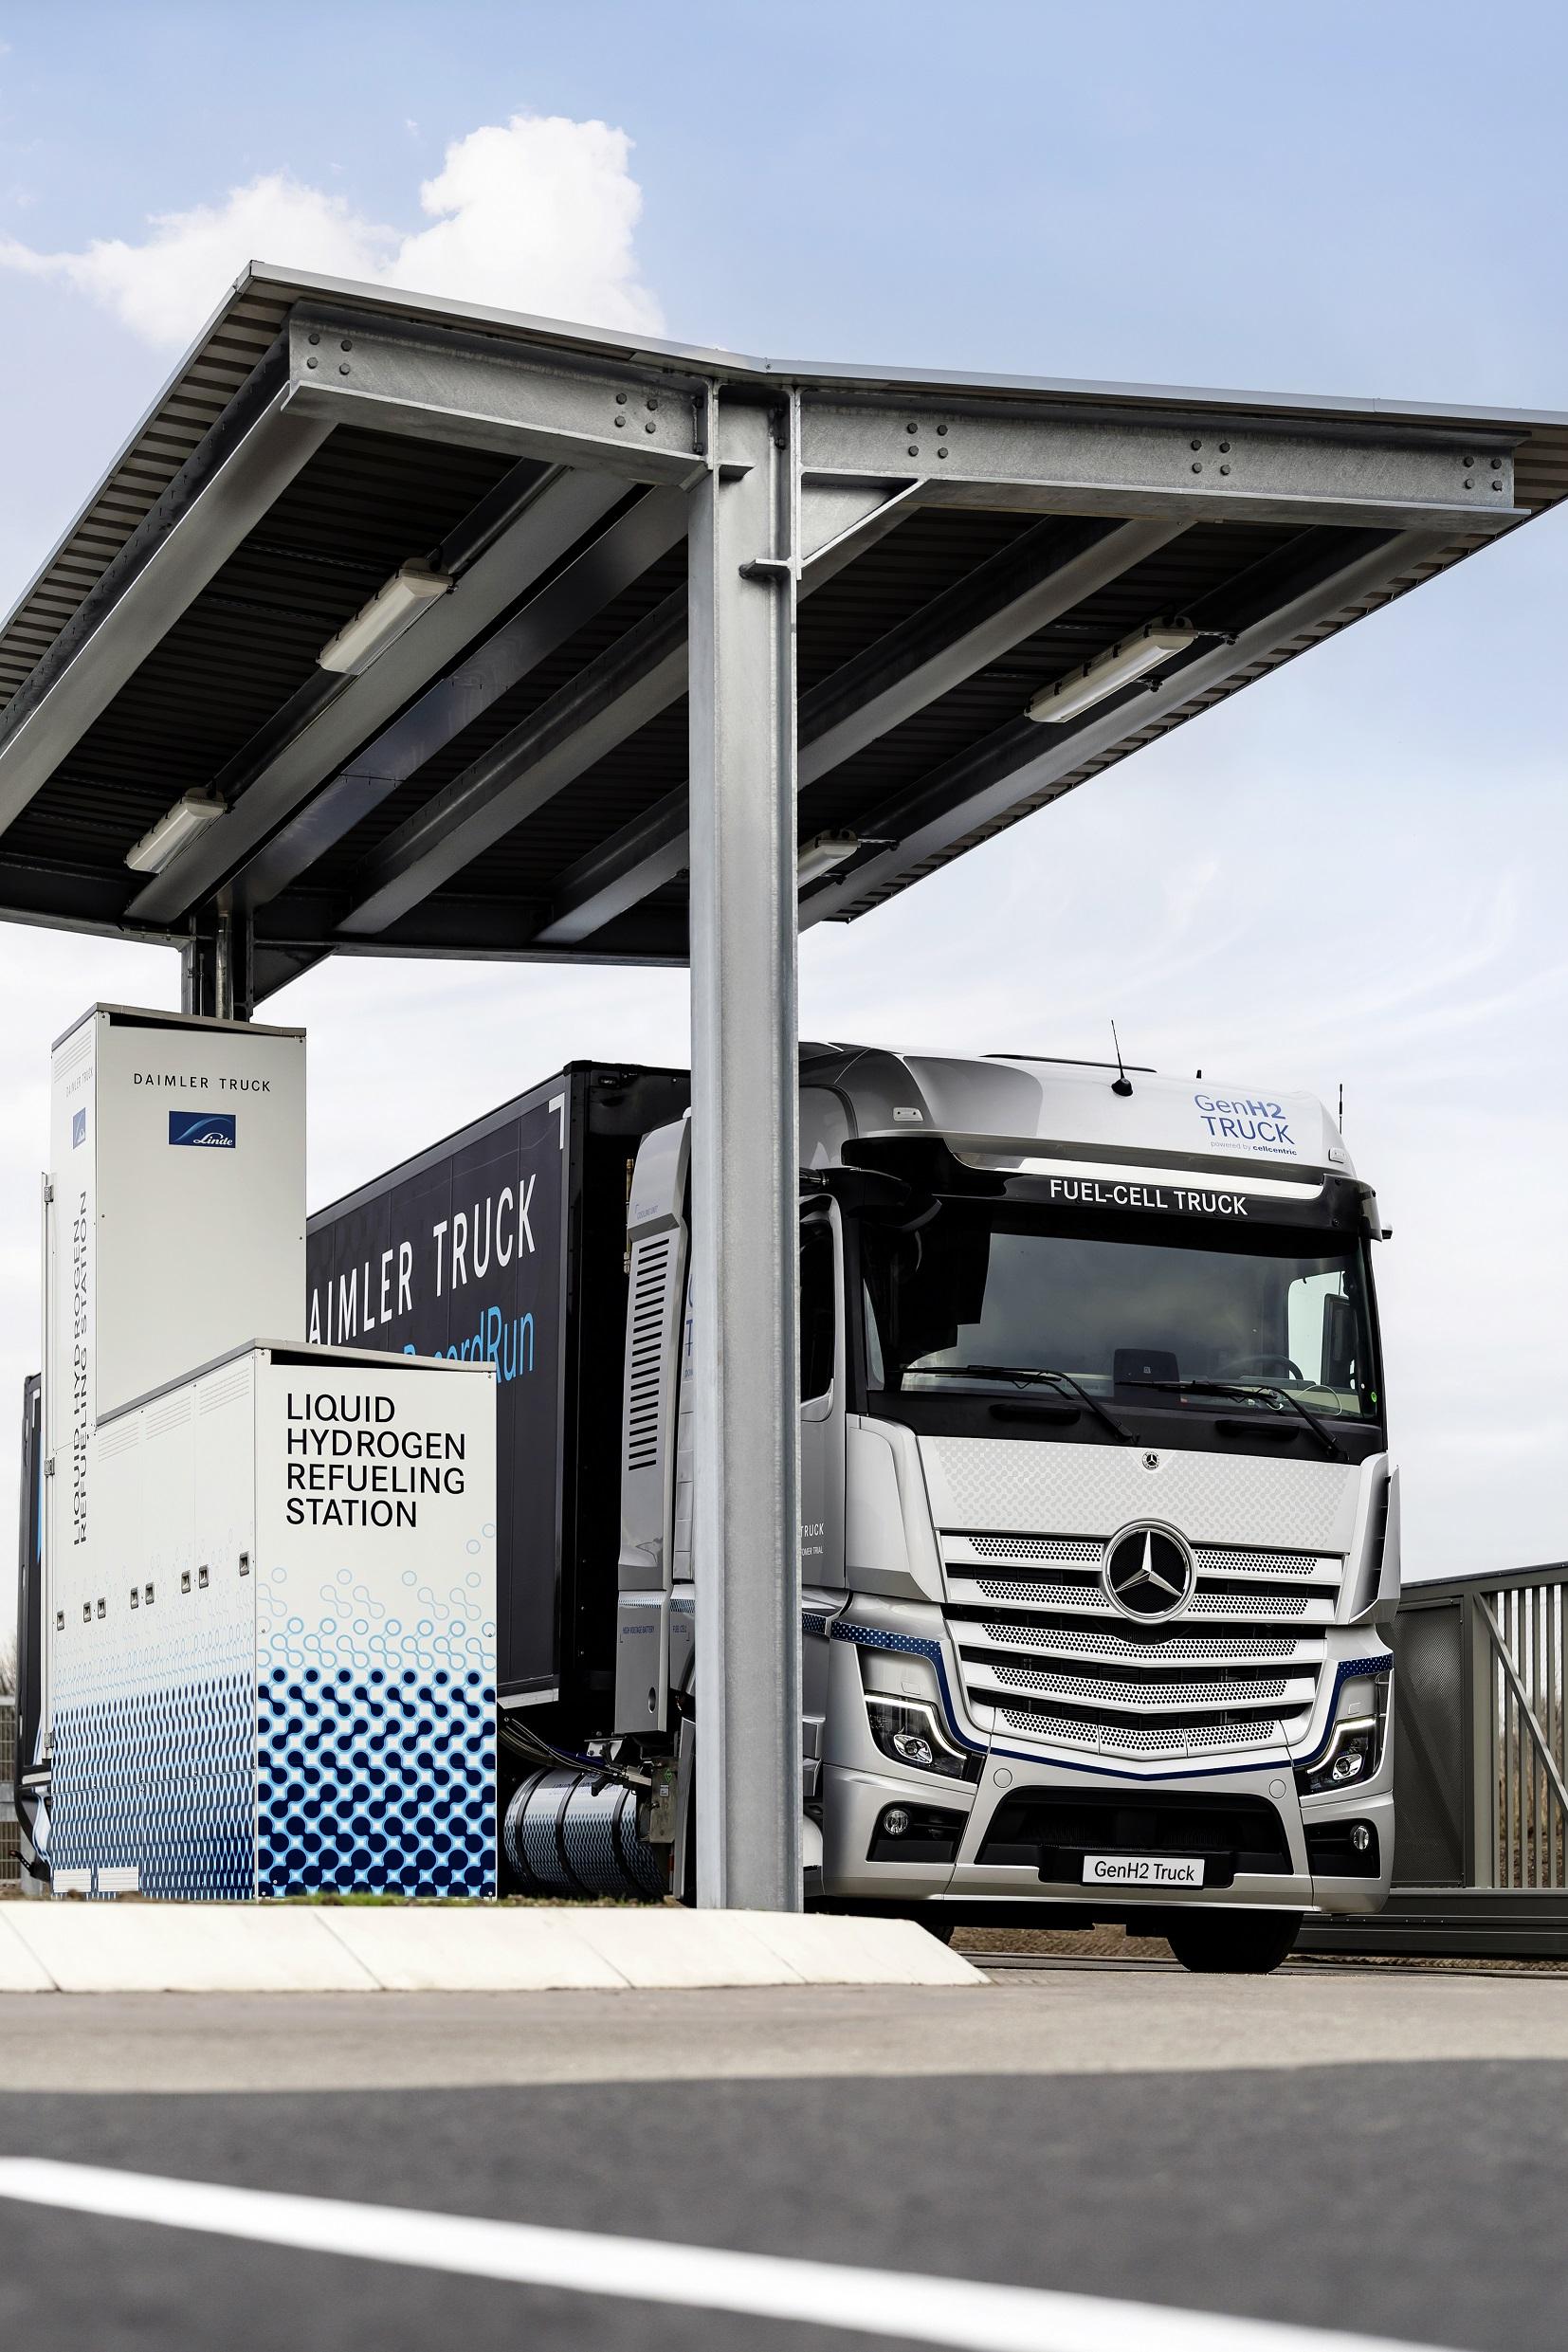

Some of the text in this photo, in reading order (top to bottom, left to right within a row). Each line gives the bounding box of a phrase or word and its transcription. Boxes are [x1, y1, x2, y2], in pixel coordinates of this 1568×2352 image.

[133, 1072, 271, 1092] DAIMLER TRUCK
[1194, 1093, 1286, 1121] GenH2
[192, 1132, 233, 1146] Linde
[1200, 1115, 1295, 1145] TRUCK
[1252, 1145, 1298, 1156] cellcentric
[1049, 1179, 1249, 1215] FUEL-CELL TRUCK
[309, 1174, 537, 1345] AIMLER TRUCK
[287, 1393, 395, 1423] LIQUID
[287, 1428, 465, 1460] HYDROGEN
[287, 1463, 465, 1495] REFUELING
[285, 1497, 417, 1527] STATION
[1094, 1860, 1195, 1882] GenH2 Truck
